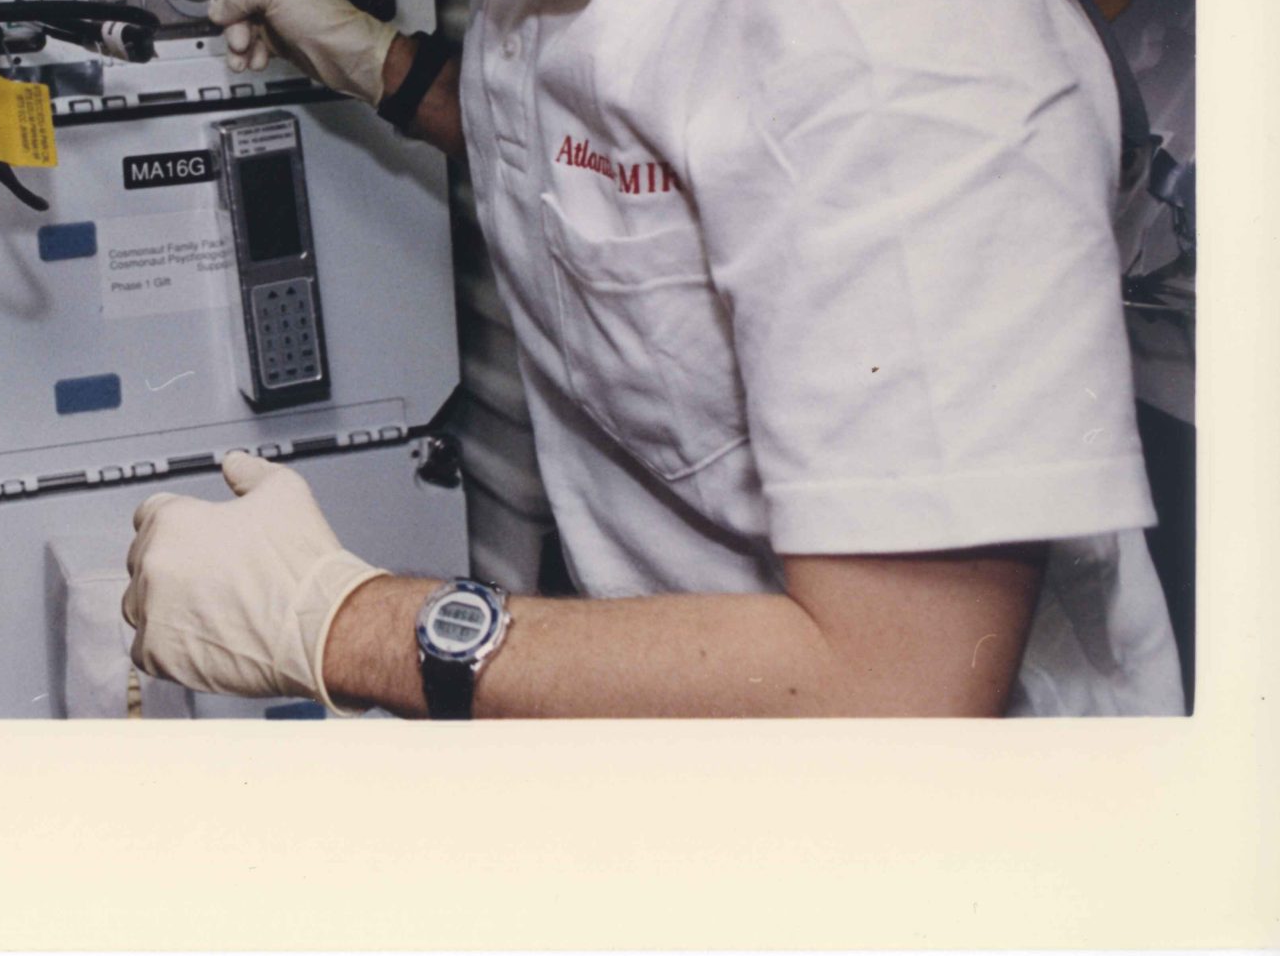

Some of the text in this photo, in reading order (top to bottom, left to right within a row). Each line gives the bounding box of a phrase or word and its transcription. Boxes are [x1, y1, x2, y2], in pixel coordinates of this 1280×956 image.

[131, 157, 205, 181] MA16G
[108, 245, 165, 259] Cosmonaut
[110, 257, 166, 271] Cosmonaut
[111, 281, 142, 292] Phase
